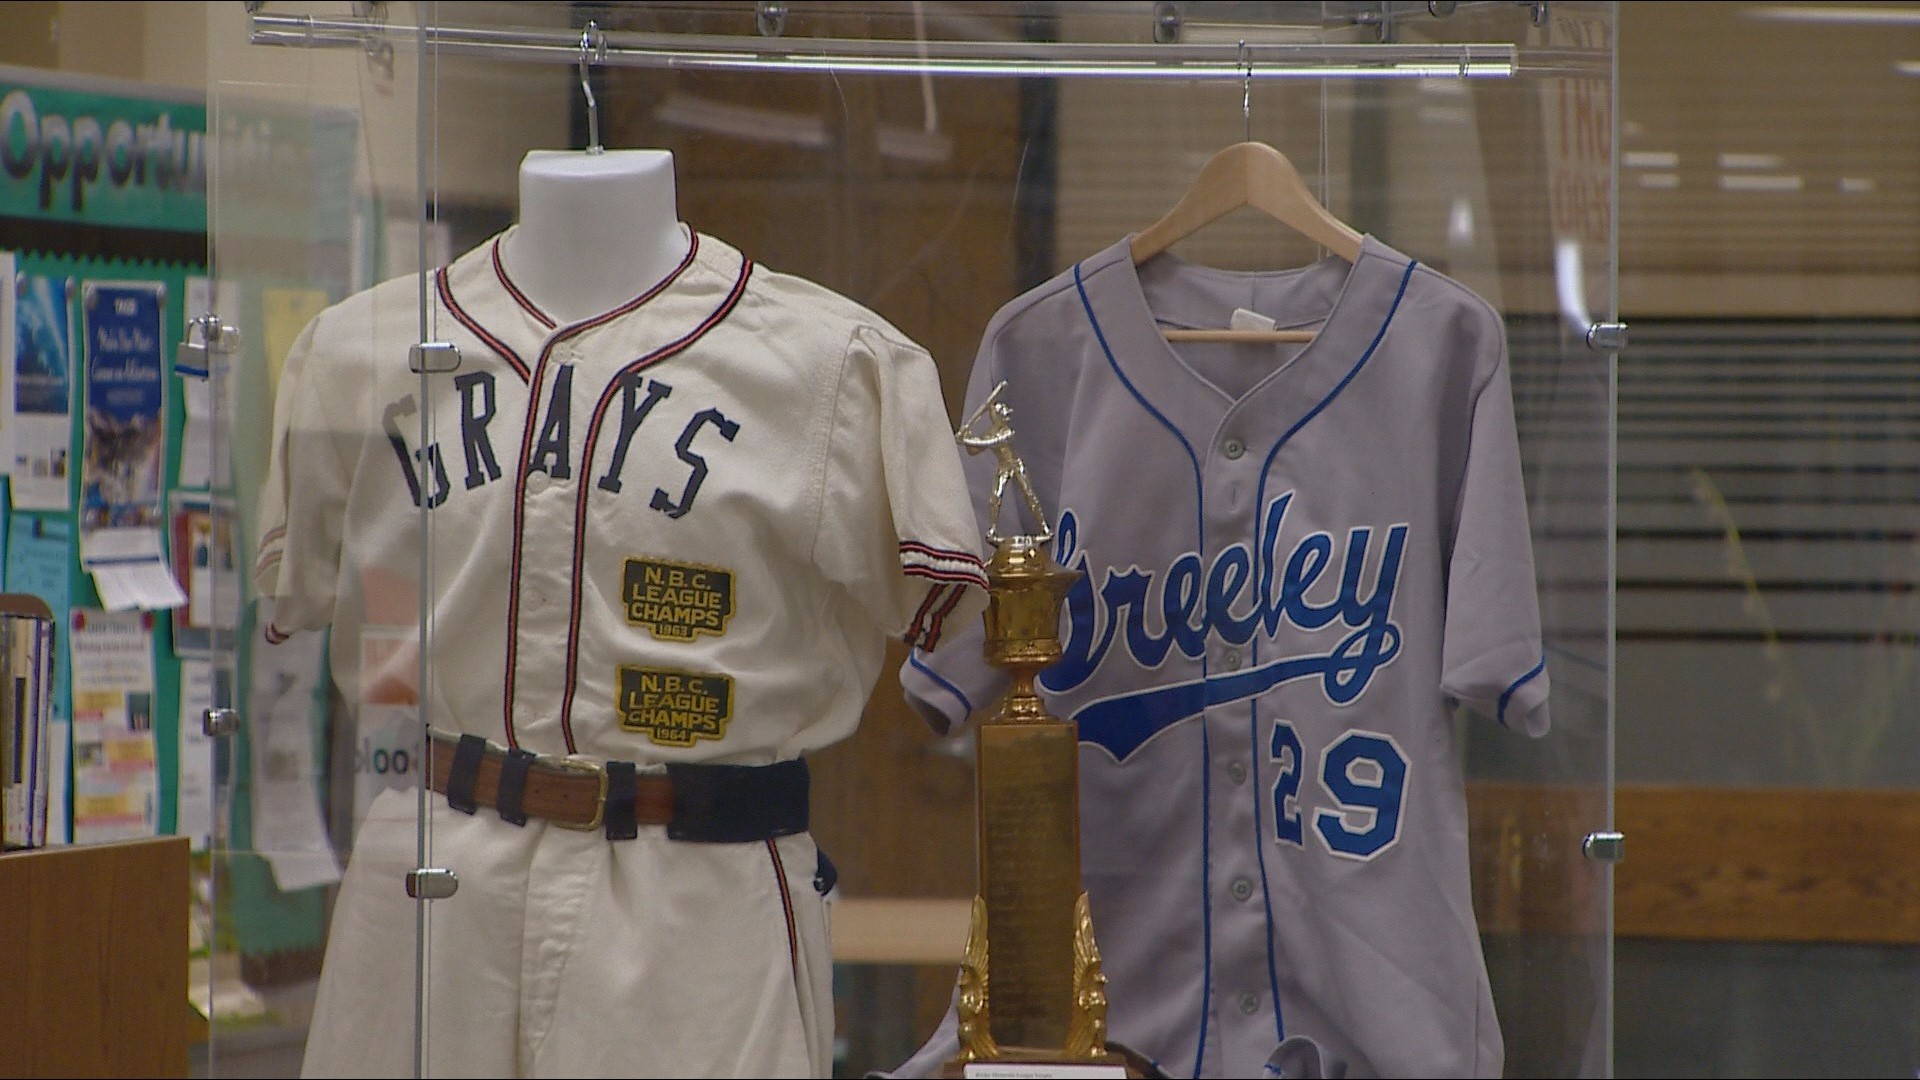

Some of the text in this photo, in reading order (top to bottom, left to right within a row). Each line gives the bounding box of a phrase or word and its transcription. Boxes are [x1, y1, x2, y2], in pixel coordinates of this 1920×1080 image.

[382, 364, 740, 519] GRAYS
[632, 584, 722, 609] LEAGUE
[632, 602, 720, 627] CHAMPS
[659, 624, 689, 637] 1963
[629, 691, 720, 714] LEAGUE
[628, 710, 716, 731] CHAMPS
[657, 728, 687, 741] 1964
[1270, 718, 1412, 863] 29
